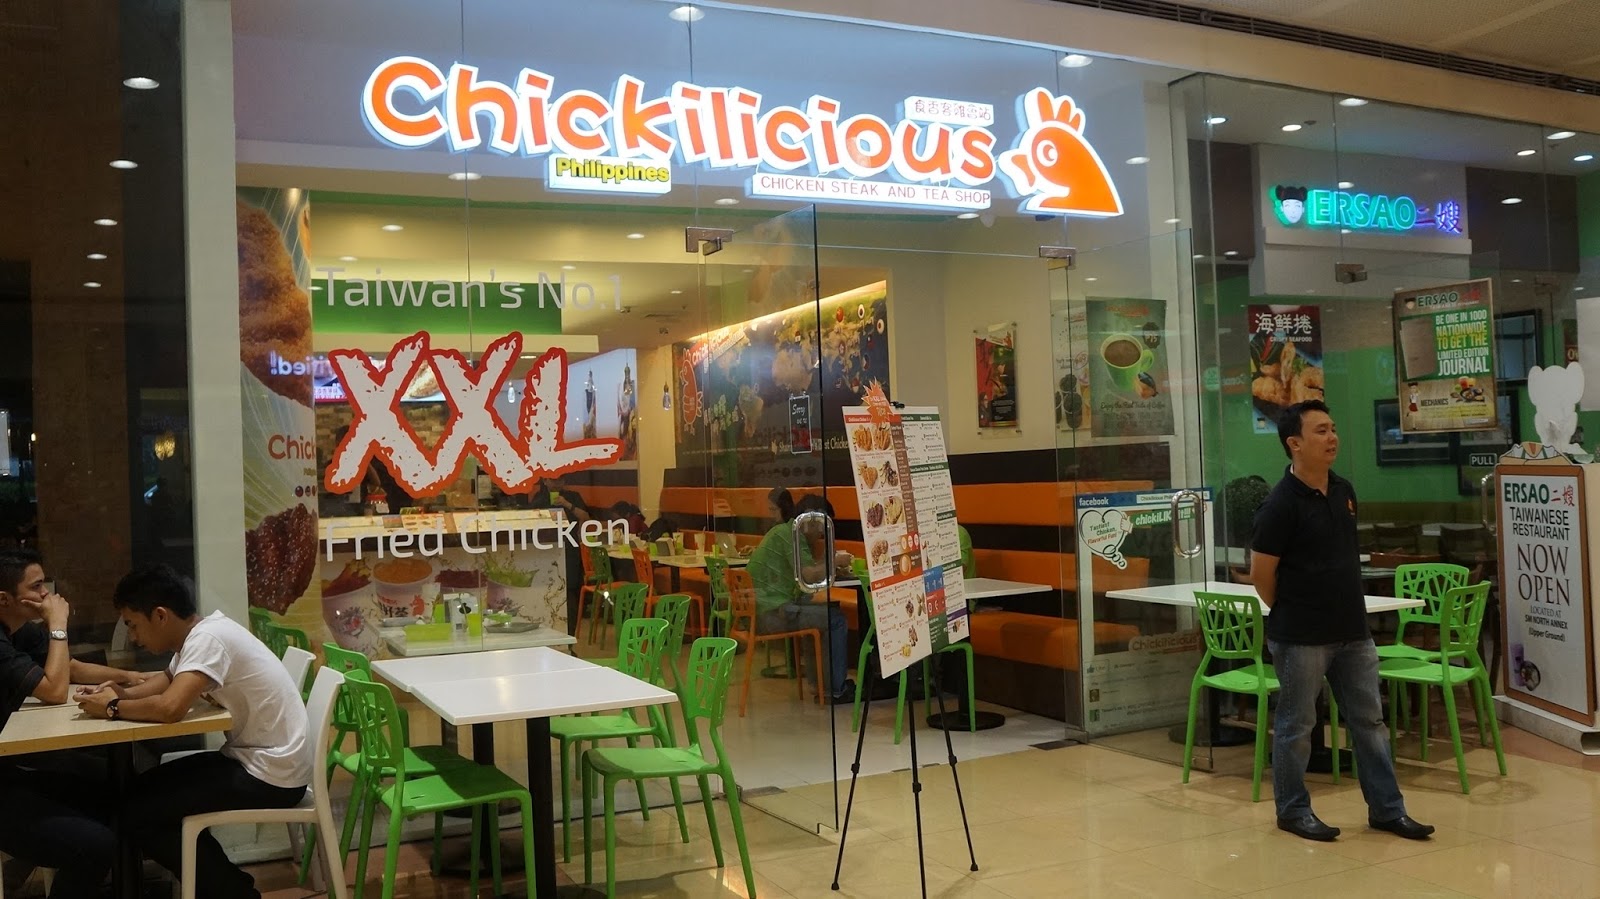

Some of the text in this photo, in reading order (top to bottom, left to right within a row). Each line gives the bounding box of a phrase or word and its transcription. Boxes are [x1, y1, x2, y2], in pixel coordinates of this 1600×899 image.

[365, 57, 996, 185] Chickilicious
[556, 156, 670, 184] Philippines
[760, 175, 991, 205] CHICKEN STEAK AND TEA SHOP
[1310, 189, 1463, 234] ERSAO 二嫂
[316, 266, 622, 310] Taiwan's No.1
[1417, 292, 1458, 307] ERSAO
[1435, 309, 1488, 325] BE ONE IN 1000
[1435, 321, 1488, 338] NATIONWIDE
[1437, 332, 1488, 350] TO GET THE
[1437, 347, 1489, 361] LIMITED EDITION
[1437, 357, 1490, 376] JOURNAL
[1420, 398, 1449, 407] MECHANICS
[324, 331, 625, 499] XXL
[1471, 456, 1494, 465] PULL
[1079, 497, 1109, 506] facebook
[1504, 482, 1550, 505] ERSAO
[1135, 512, 1172, 525] chickiLIK
[1510, 506, 1569, 526] TAIWANESE
[1089, 521, 1110, 532] Tastiest
[1512, 523, 1571, 541] RESTAURANT
[326, 510, 631, 562] Fried Chicken
[1517, 543, 1569, 576] NOW
[1518, 573, 1571, 606] OPEN
[1530, 605, 1562, 618] LOCATED AT
[1525, 614, 1568, 630] SM NORTH ANNEX
[1528, 626, 1566, 643] (Upper Ground)
